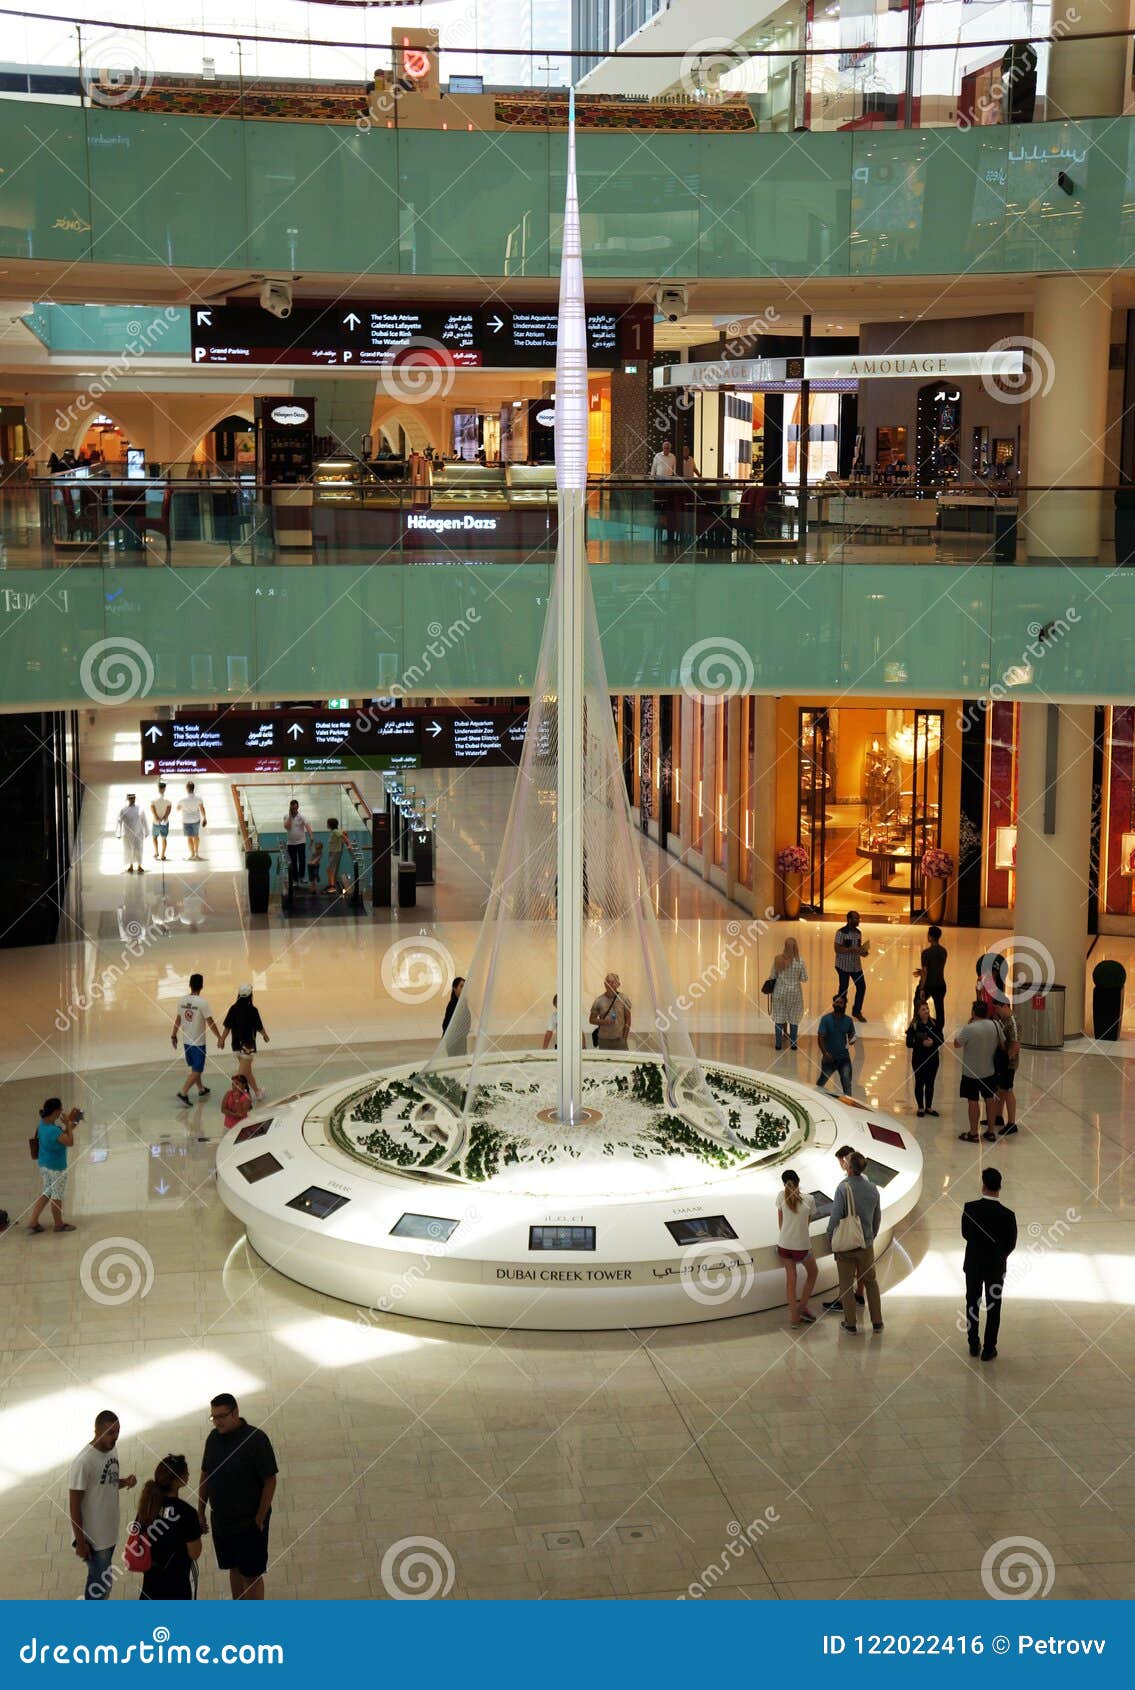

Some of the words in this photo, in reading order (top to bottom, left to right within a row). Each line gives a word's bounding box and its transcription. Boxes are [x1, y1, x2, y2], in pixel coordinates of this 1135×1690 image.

[851, 358, 948, 374] AMOUAGE
[407, 515, 496, 533] Häagen-Dazs
[496, 1268, 536, 1281] DUBAI
[540, 1269, 583, 1281] CREEK
[587, 1269, 633, 1281] TOWER
